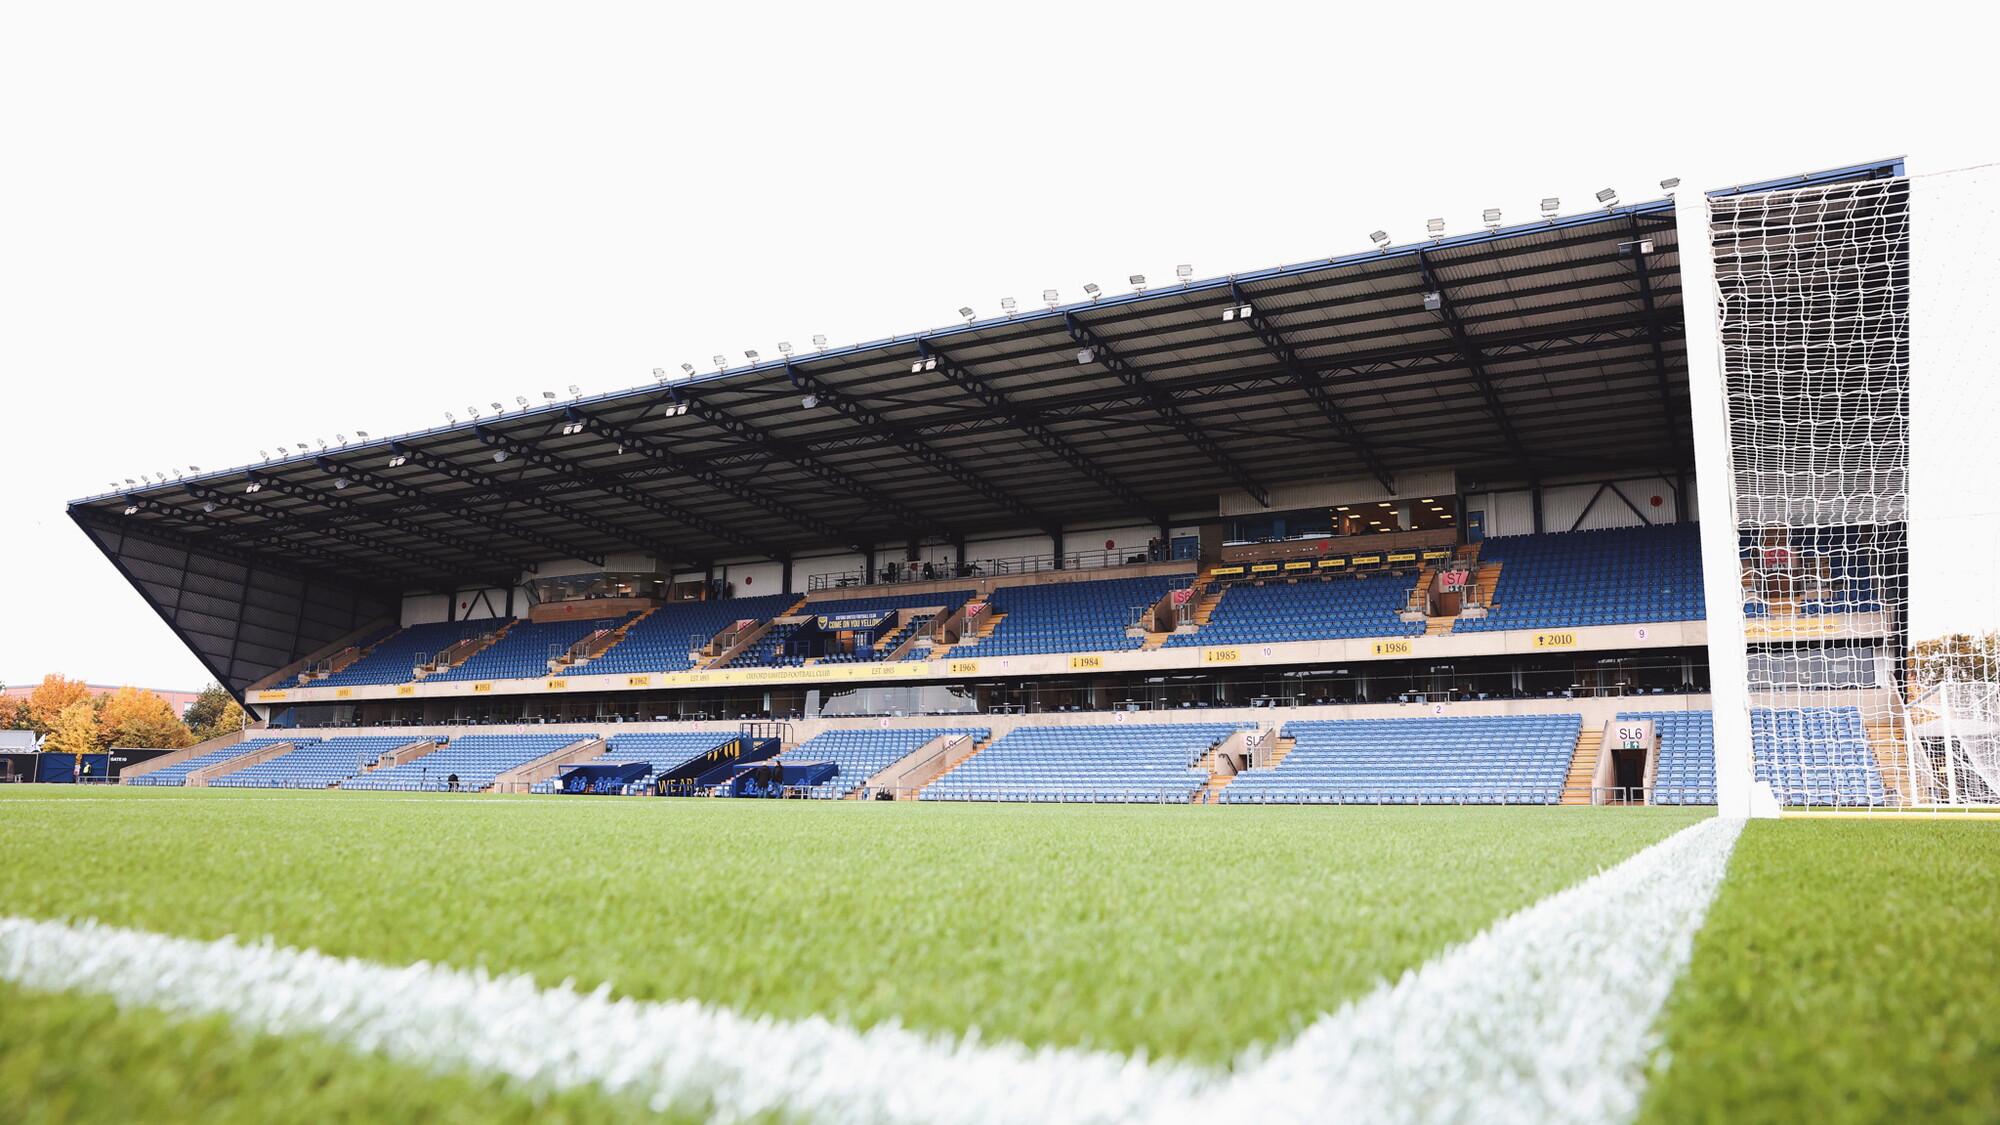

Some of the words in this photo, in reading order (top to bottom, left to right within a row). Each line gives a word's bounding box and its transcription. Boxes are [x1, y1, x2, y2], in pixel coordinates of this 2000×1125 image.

[1447, 572, 1462, 584] S7
[1178, 591, 1191, 602] S6
[828, 620, 842, 629] COME
[843, 619, 850, 628] ON
[850, 619, 860, 628] YOU
[1639, 629, 1645, 638] 9
[1547, 635, 1573, 646] 2010
[1263, 647, 1272, 656] 10
[1385, 642, 1408, 653] 1986
[1215, 650, 1237, 661] 1985
[959, 663, 976, 672] 1968
[1003, 660, 1009, 668] 11
[1081, 657, 1099, 667] 1984
[746, 672, 768, 680] OXFORD
[768, 671, 788, 679] UNITED
[788, 670, 815, 678] FOOTBALL
[816, 669, 831, 677] CLUB
[1436, 705, 1442, 714] 2
[1619, 727, 1643, 740] SL6
[657, 779, 676, 793] WE
